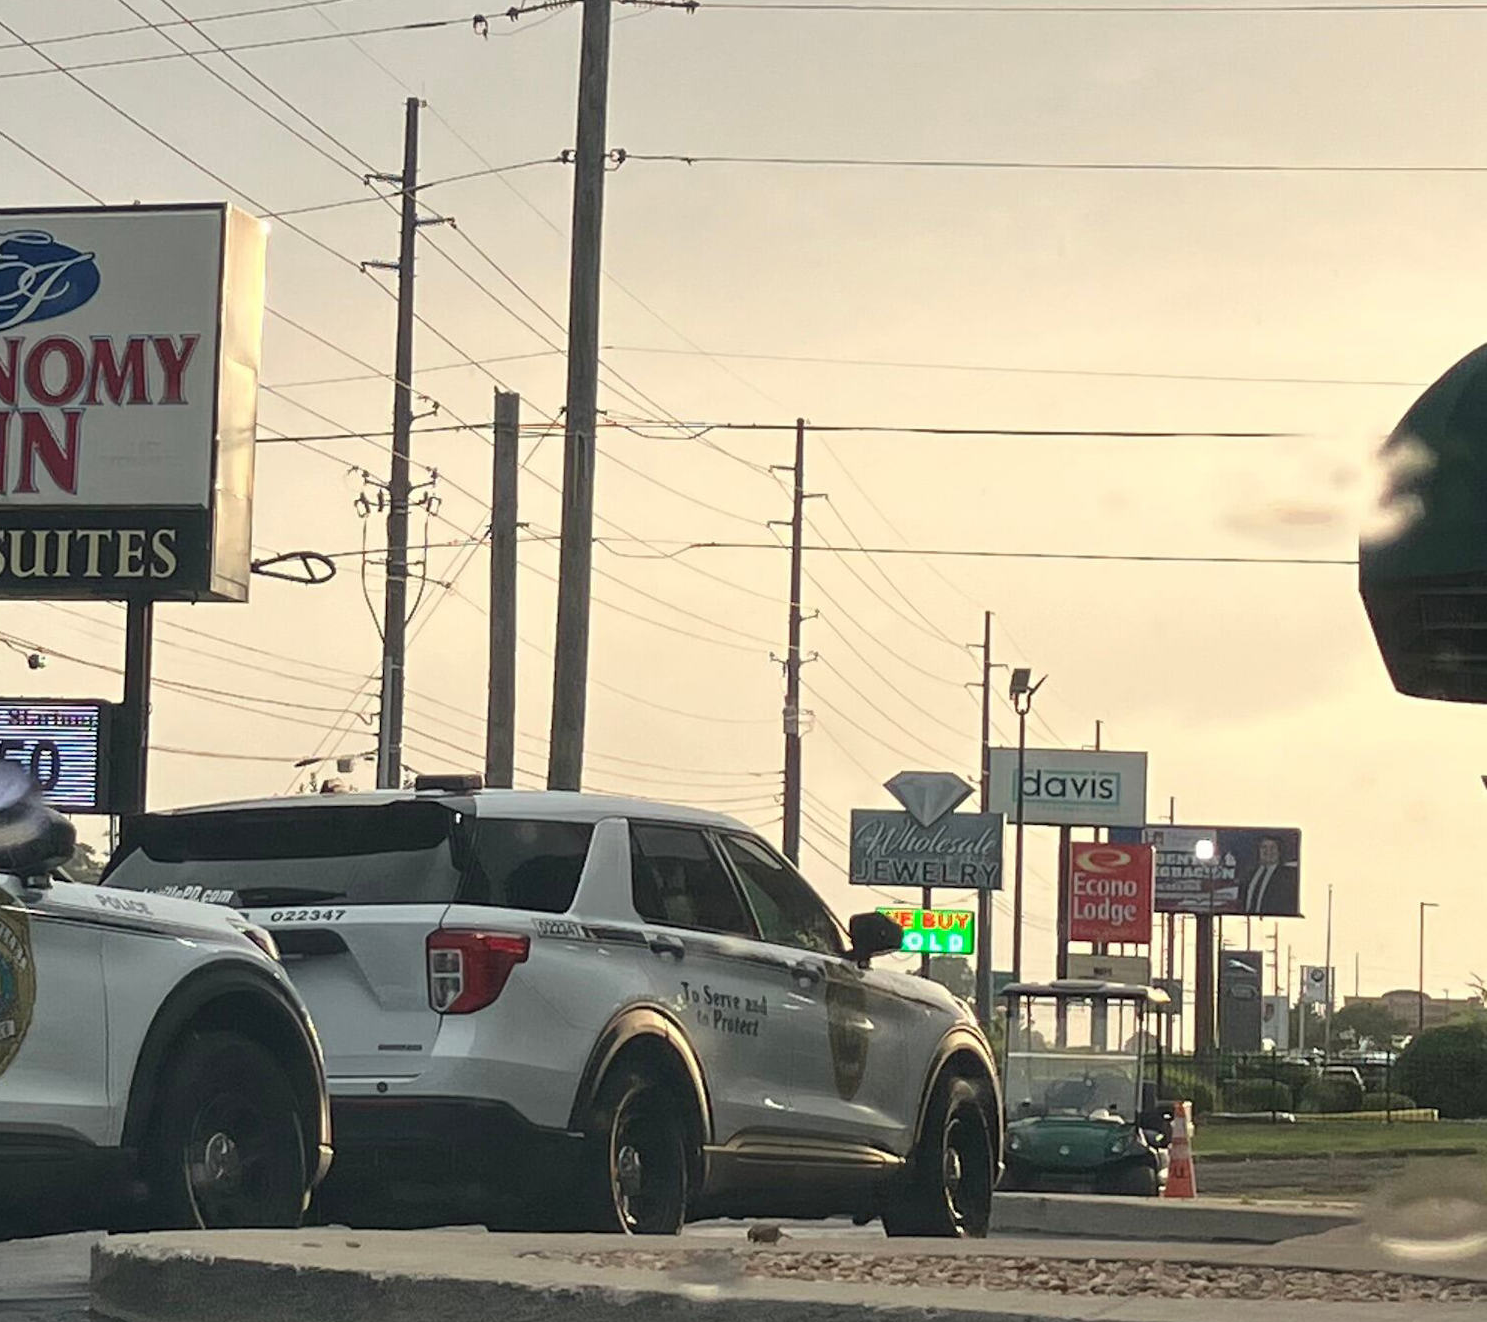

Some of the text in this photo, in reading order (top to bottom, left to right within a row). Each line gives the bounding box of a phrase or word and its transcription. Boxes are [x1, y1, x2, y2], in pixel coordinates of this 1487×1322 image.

[1021, 769, 1114, 799] davis
[854, 819, 997, 855] Wholesale
[855, 858, 999, 887] JEWELRY
[1074, 872, 1137, 897] Econo
[95, 894, 154, 916] POLICE
[270, 909, 347, 923] 022347
[1074, 897, 1137, 926] Lodge
[923, 912, 969, 929] BUY
[903, 932, 964, 952] OLD
[681, 981, 700, 1003] To
[704, 985, 740, 1010] Serve
[714, 1009, 759, 1037] Protect
